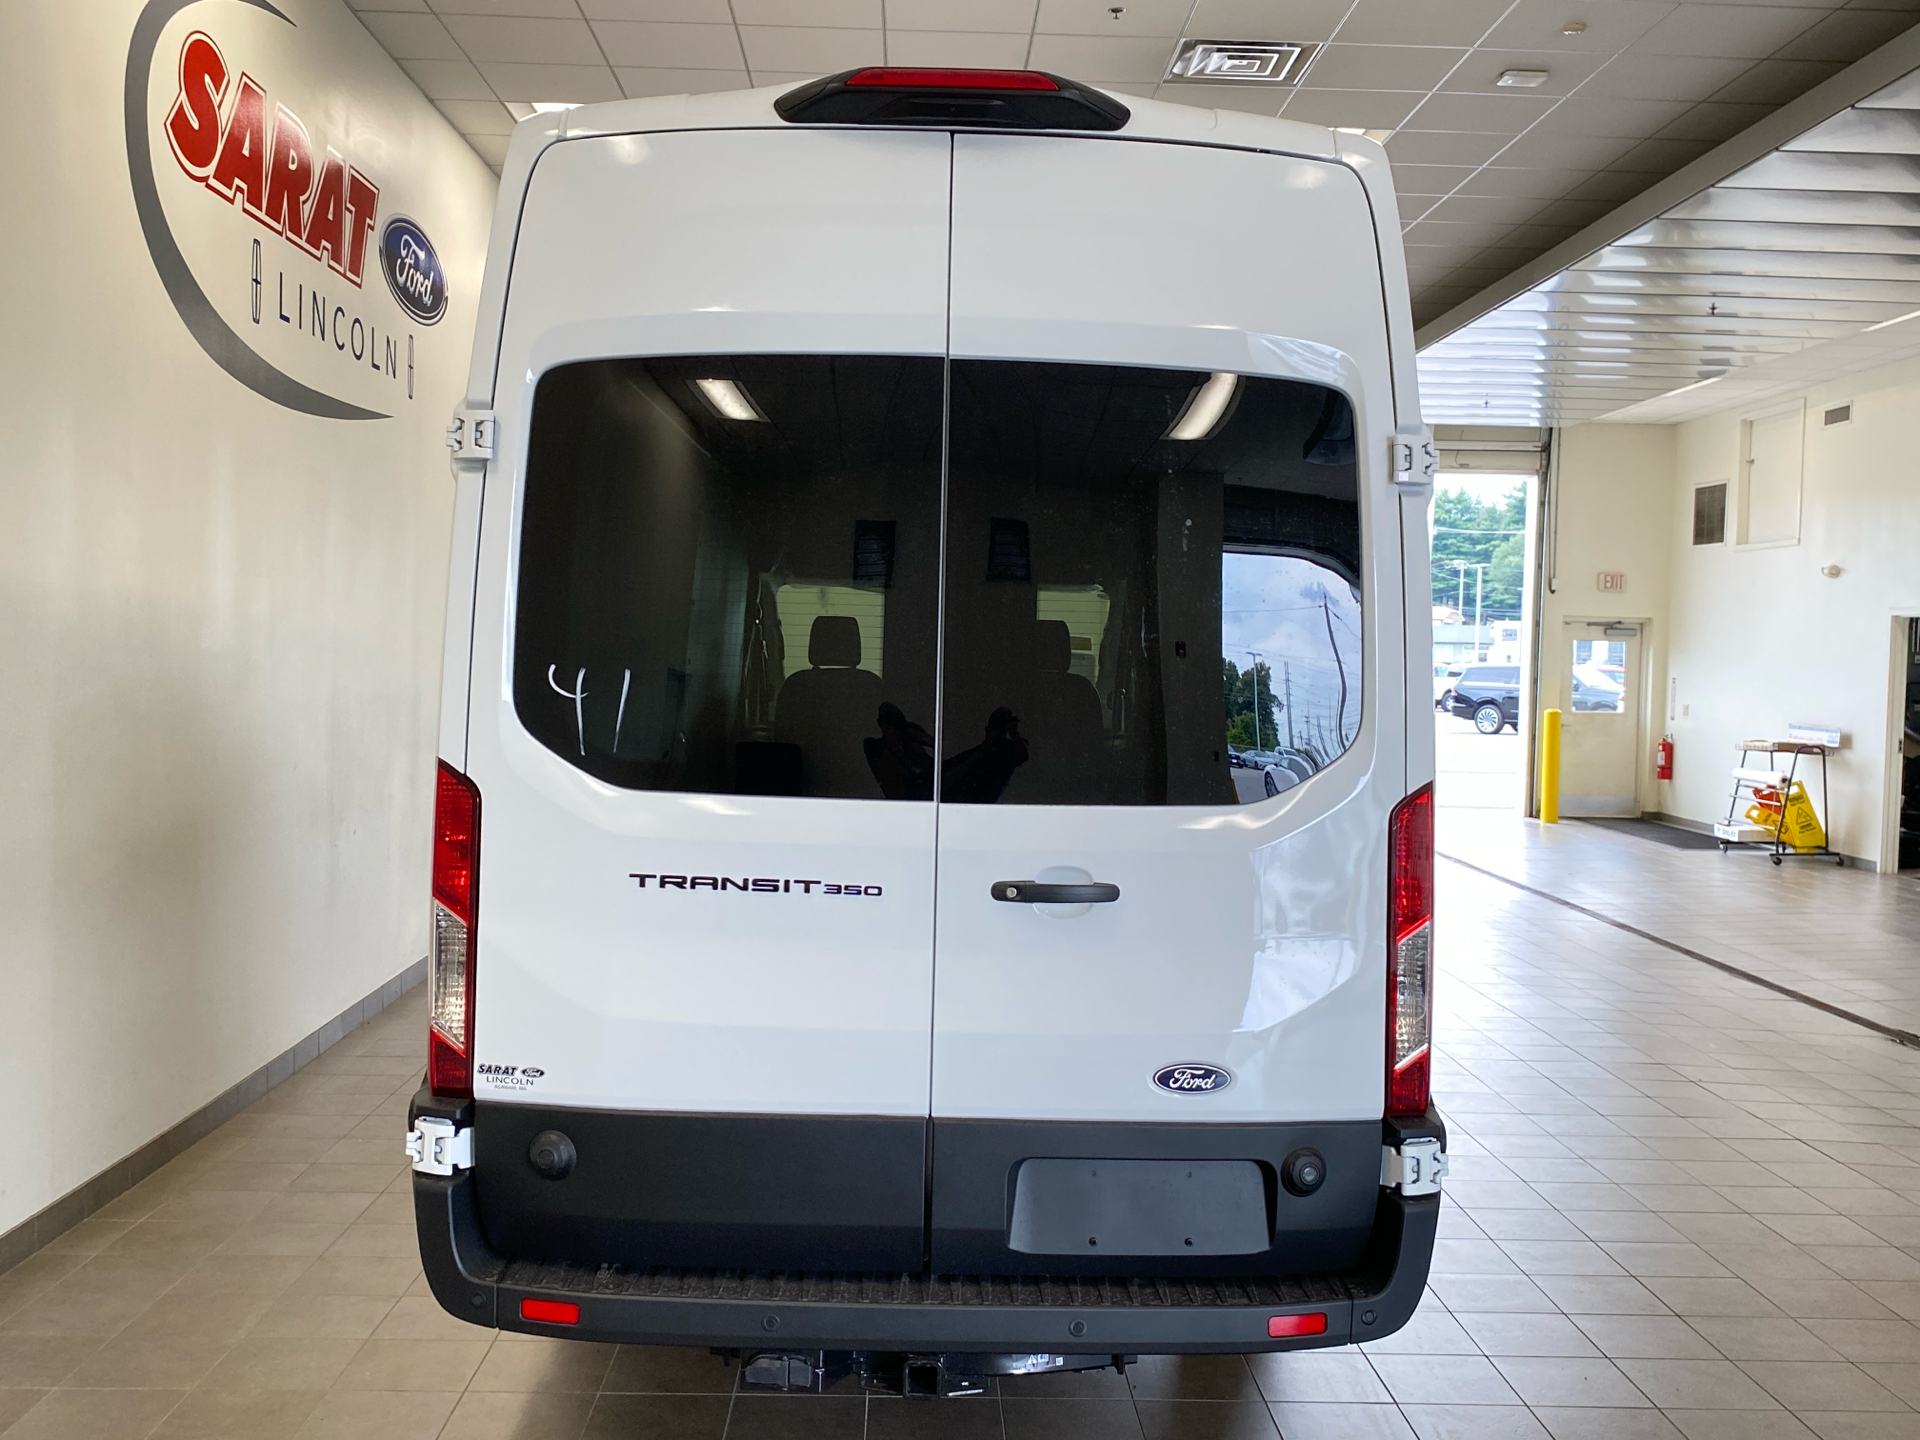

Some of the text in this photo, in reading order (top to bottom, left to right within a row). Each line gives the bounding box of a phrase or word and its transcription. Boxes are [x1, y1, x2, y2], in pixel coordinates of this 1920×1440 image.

[164, 30, 380, 289] SARAT
[396, 234, 434, 307] Ford
[279, 271, 397, 380] LINCOLN
[1604, 573, 1624, 590] EXIT
[548, 663, 631, 756] 41
[478, 1063, 518, 1076] SARAT
[486, 1076, 534, 1086] LINCOLN
[1169, 1068, 1216, 1089] Ford
